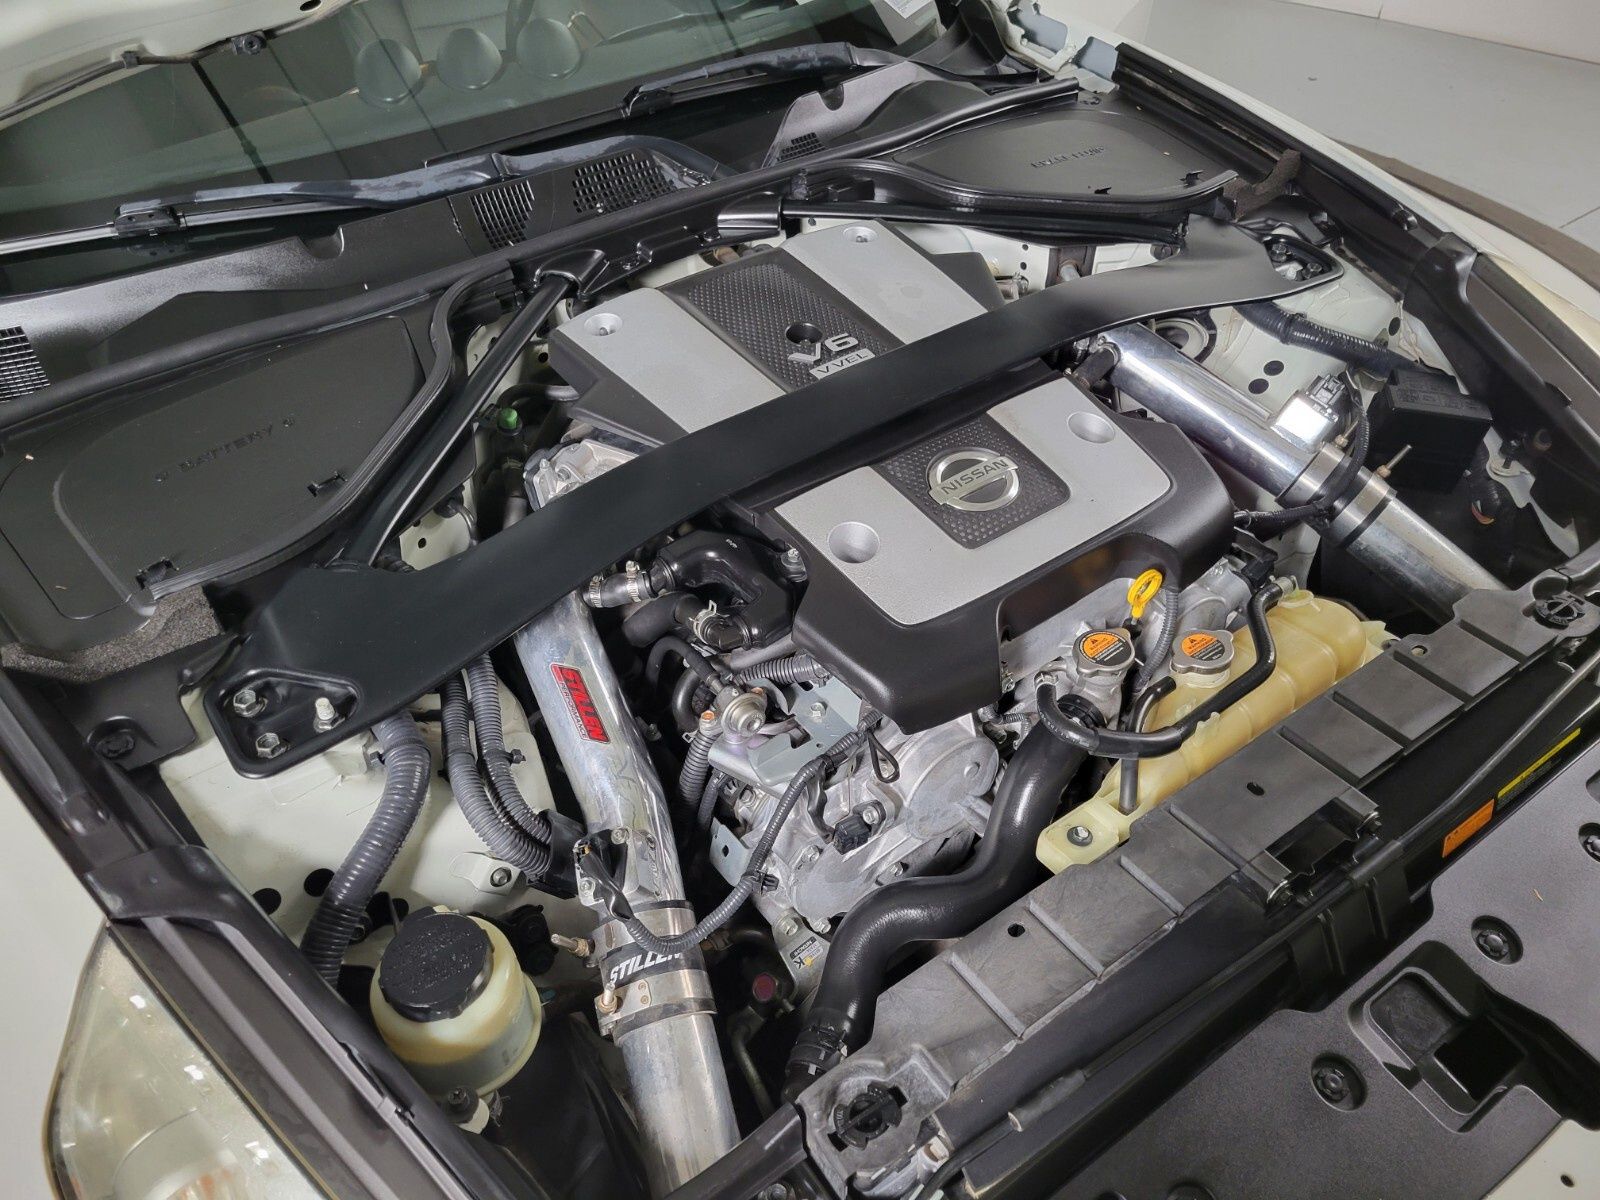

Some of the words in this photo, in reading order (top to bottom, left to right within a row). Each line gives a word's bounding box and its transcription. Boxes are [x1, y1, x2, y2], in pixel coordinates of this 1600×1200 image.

[788, 332, 859, 364] V6
[941, 459, 1009, 495] NISSAN
[560, 667, 609, 742] STILLEN
[560, 681, 587, 738] PERFORMANCE
